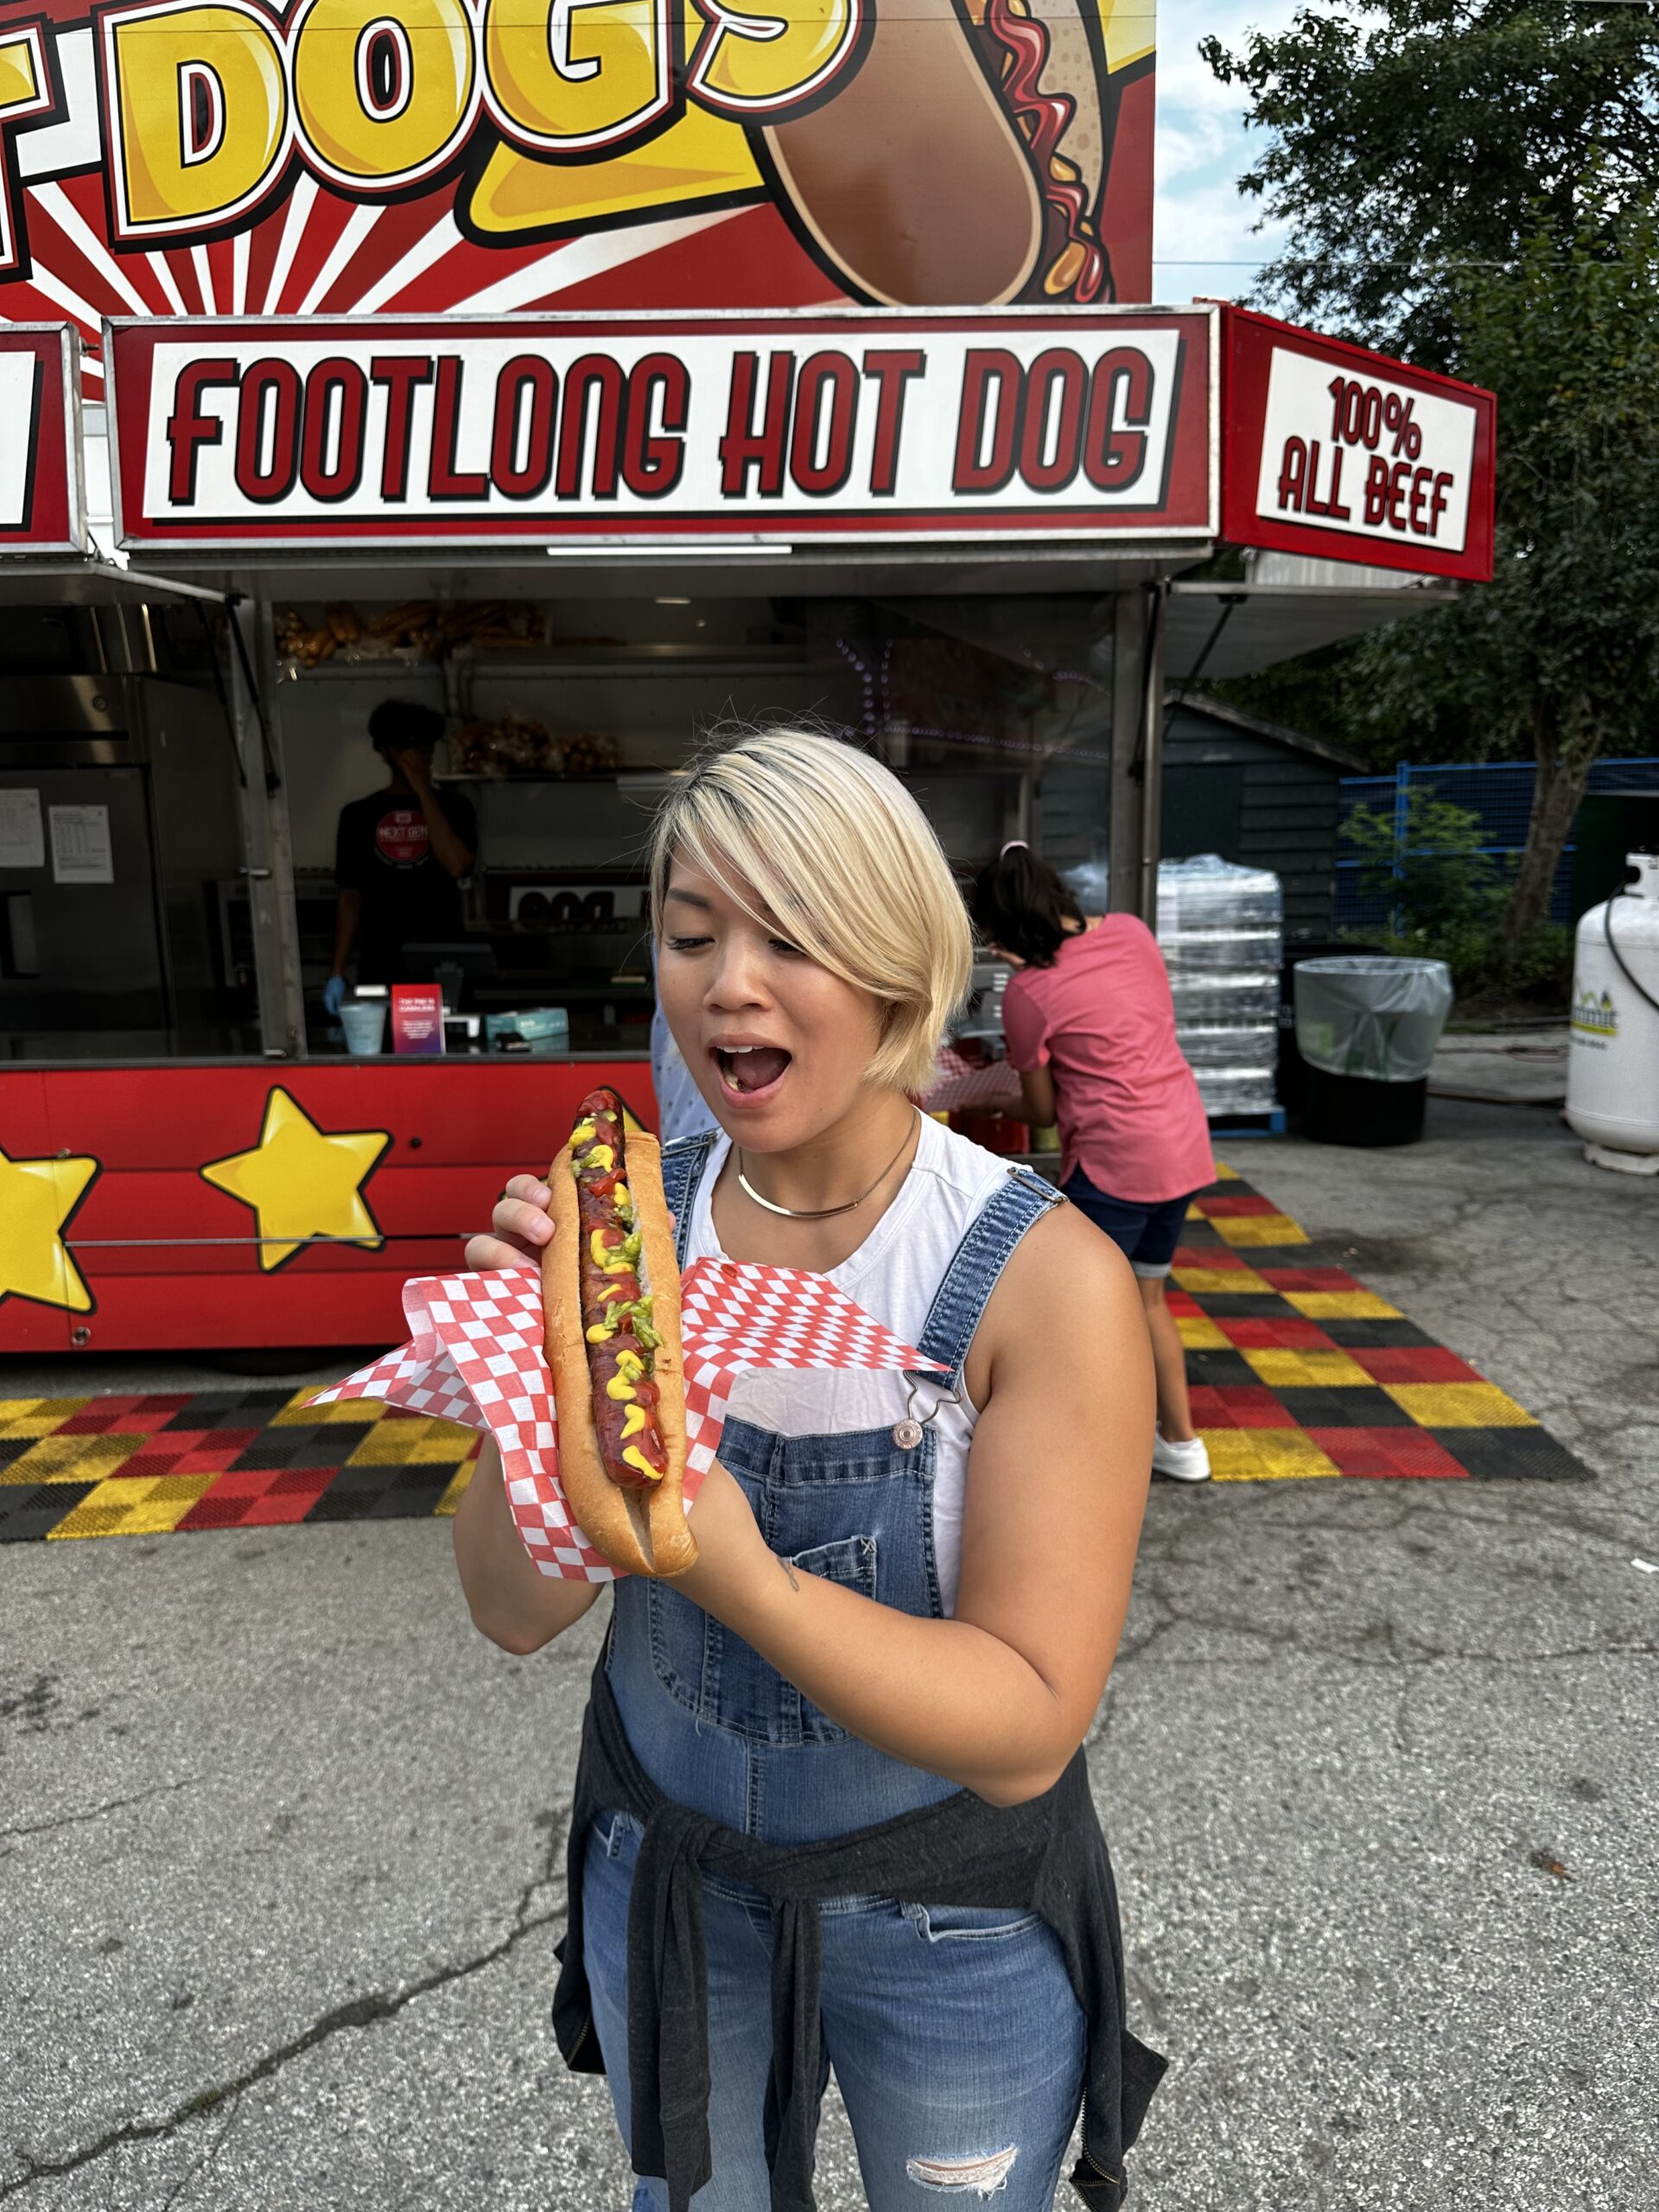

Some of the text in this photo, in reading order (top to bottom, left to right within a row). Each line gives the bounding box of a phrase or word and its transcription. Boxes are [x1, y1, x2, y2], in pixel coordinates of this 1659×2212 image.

[167, 346, 1155, 505] FOOTLONG HOT DOG
[1328, 376, 1423, 461] 100%
[1278, 435, 1454, 538] ALL BEEF
